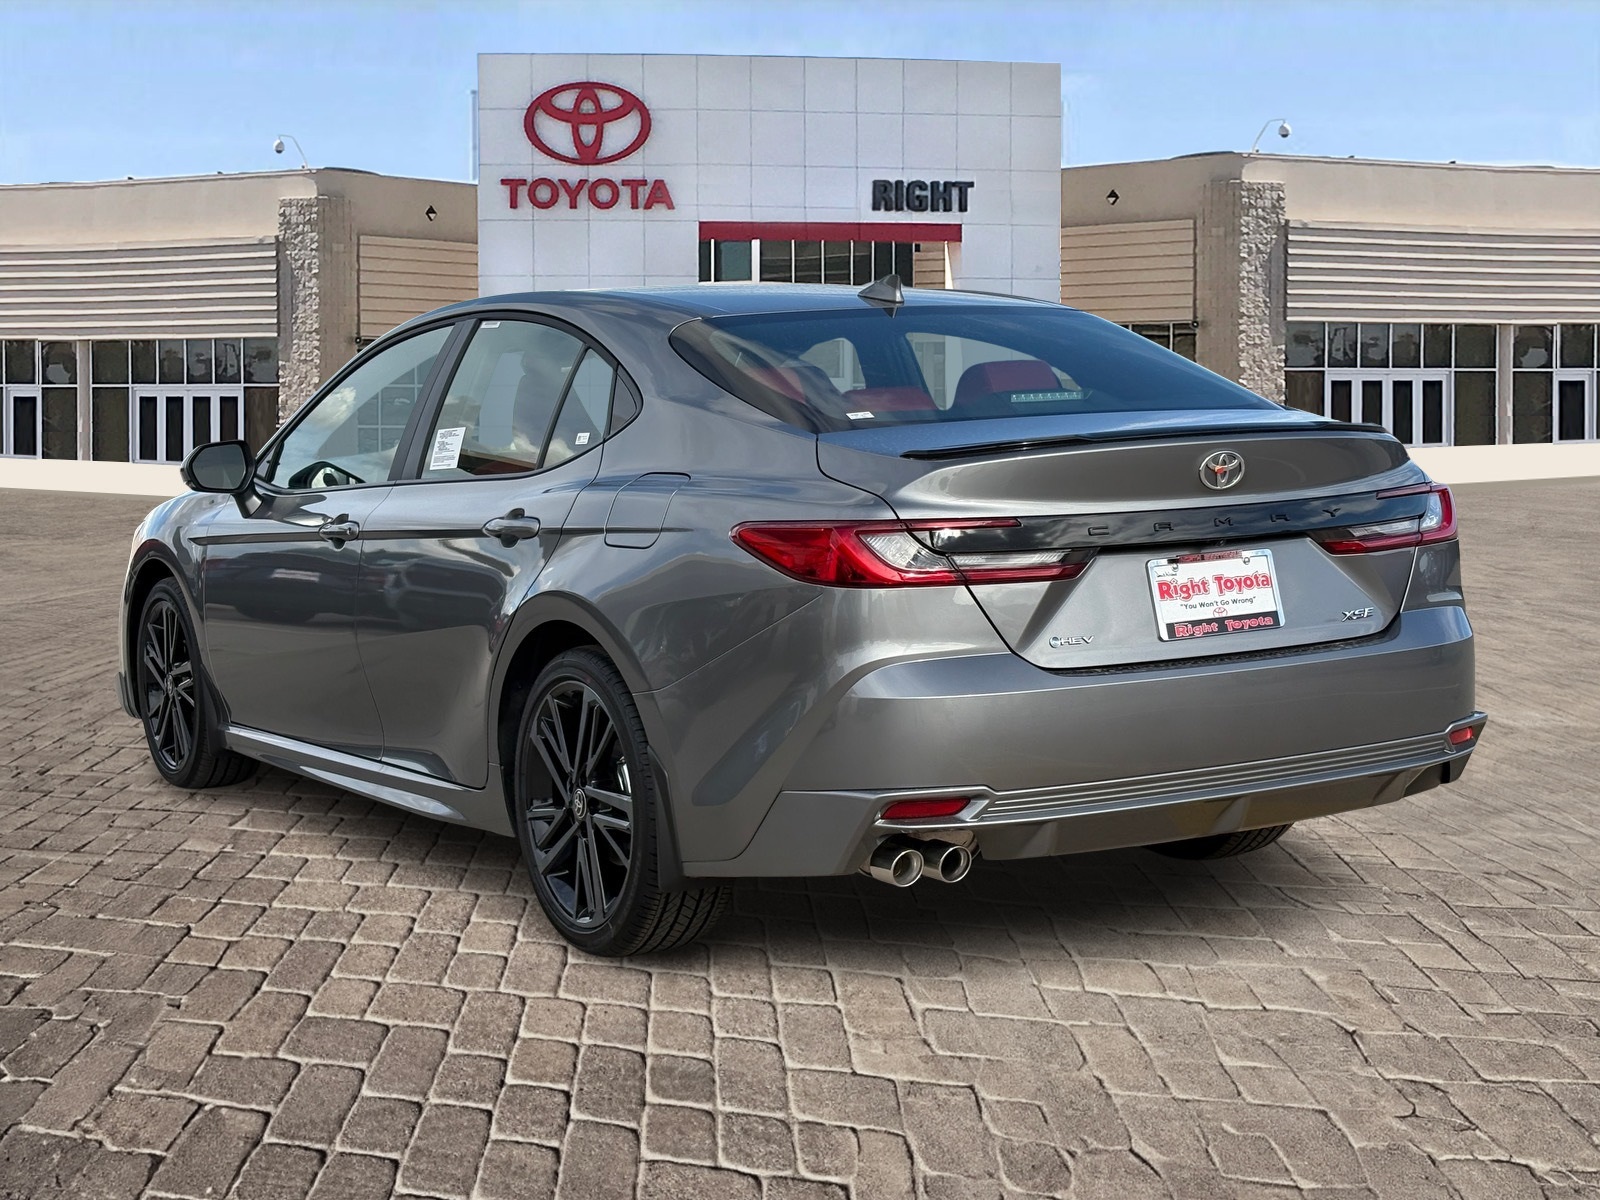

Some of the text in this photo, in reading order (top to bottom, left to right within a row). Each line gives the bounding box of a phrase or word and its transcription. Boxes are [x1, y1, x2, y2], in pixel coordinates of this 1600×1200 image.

[500, 177, 675, 210] TOYOTA
[872, 179, 975, 212] RIGHT
[1087, 506, 1342, 537] CAMRY
[1156, 572, 1272, 602] Right Toyota
[1199, 600, 1218, 608] Won't
[1341, 606, 1374, 622] XSE
[1175, 616, 1274, 637] Right Toyota
